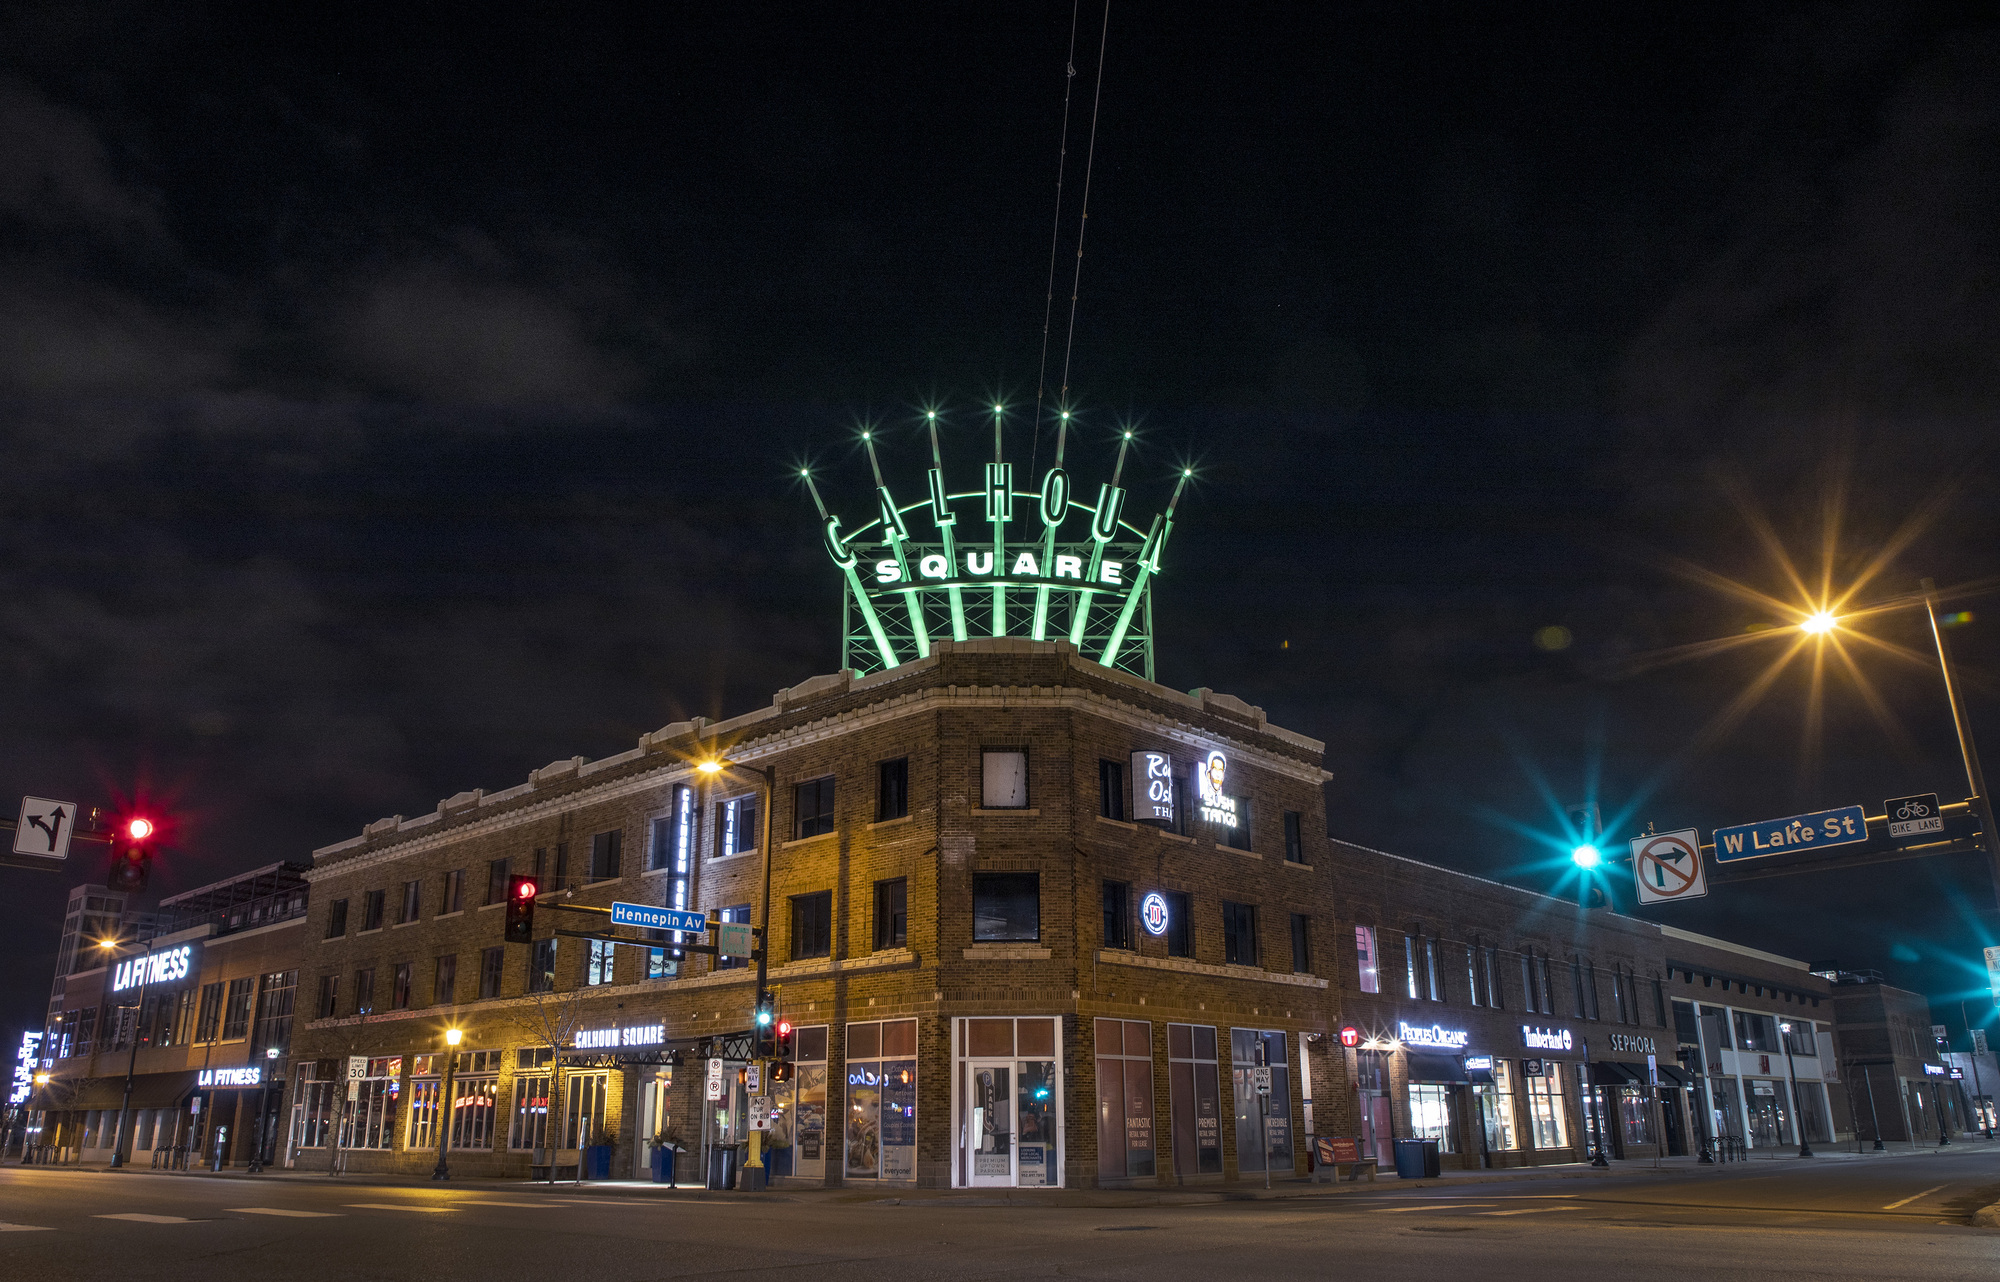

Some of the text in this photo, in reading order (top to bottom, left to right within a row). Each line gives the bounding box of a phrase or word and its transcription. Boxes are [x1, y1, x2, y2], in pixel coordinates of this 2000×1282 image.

[823, 463, 1174, 575] CALHOUN
[875, 552, 1123, 585] SQUARE
[1201, 807, 1237, 828] TANGO
[1892, 818, 1941, 834] BIKE LANE
[677, 789, 690, 873] CALHOUN
[1723, 815, 1857, 854] W Lake St
[615, 907, 702, 929] Hennepin Av
[113, 946, 191, 992] LA FITNESS
[575, 1025, 664, 1049] CALHOUN SQUARE
[1523, 1025, 1564, 1049] Timberland
[1611, 1033, 1656, 1053] SEPHORA
[198, 1067, 261, 1086] LA FITNESS
[350, 1069, 364, 1077] 30
[1126, 1117, 1151, 1128] FANTASTIC
[1198, 1117, 1217, 1128] PREMIER
[884, 1167, 911, 1176] everyone!
